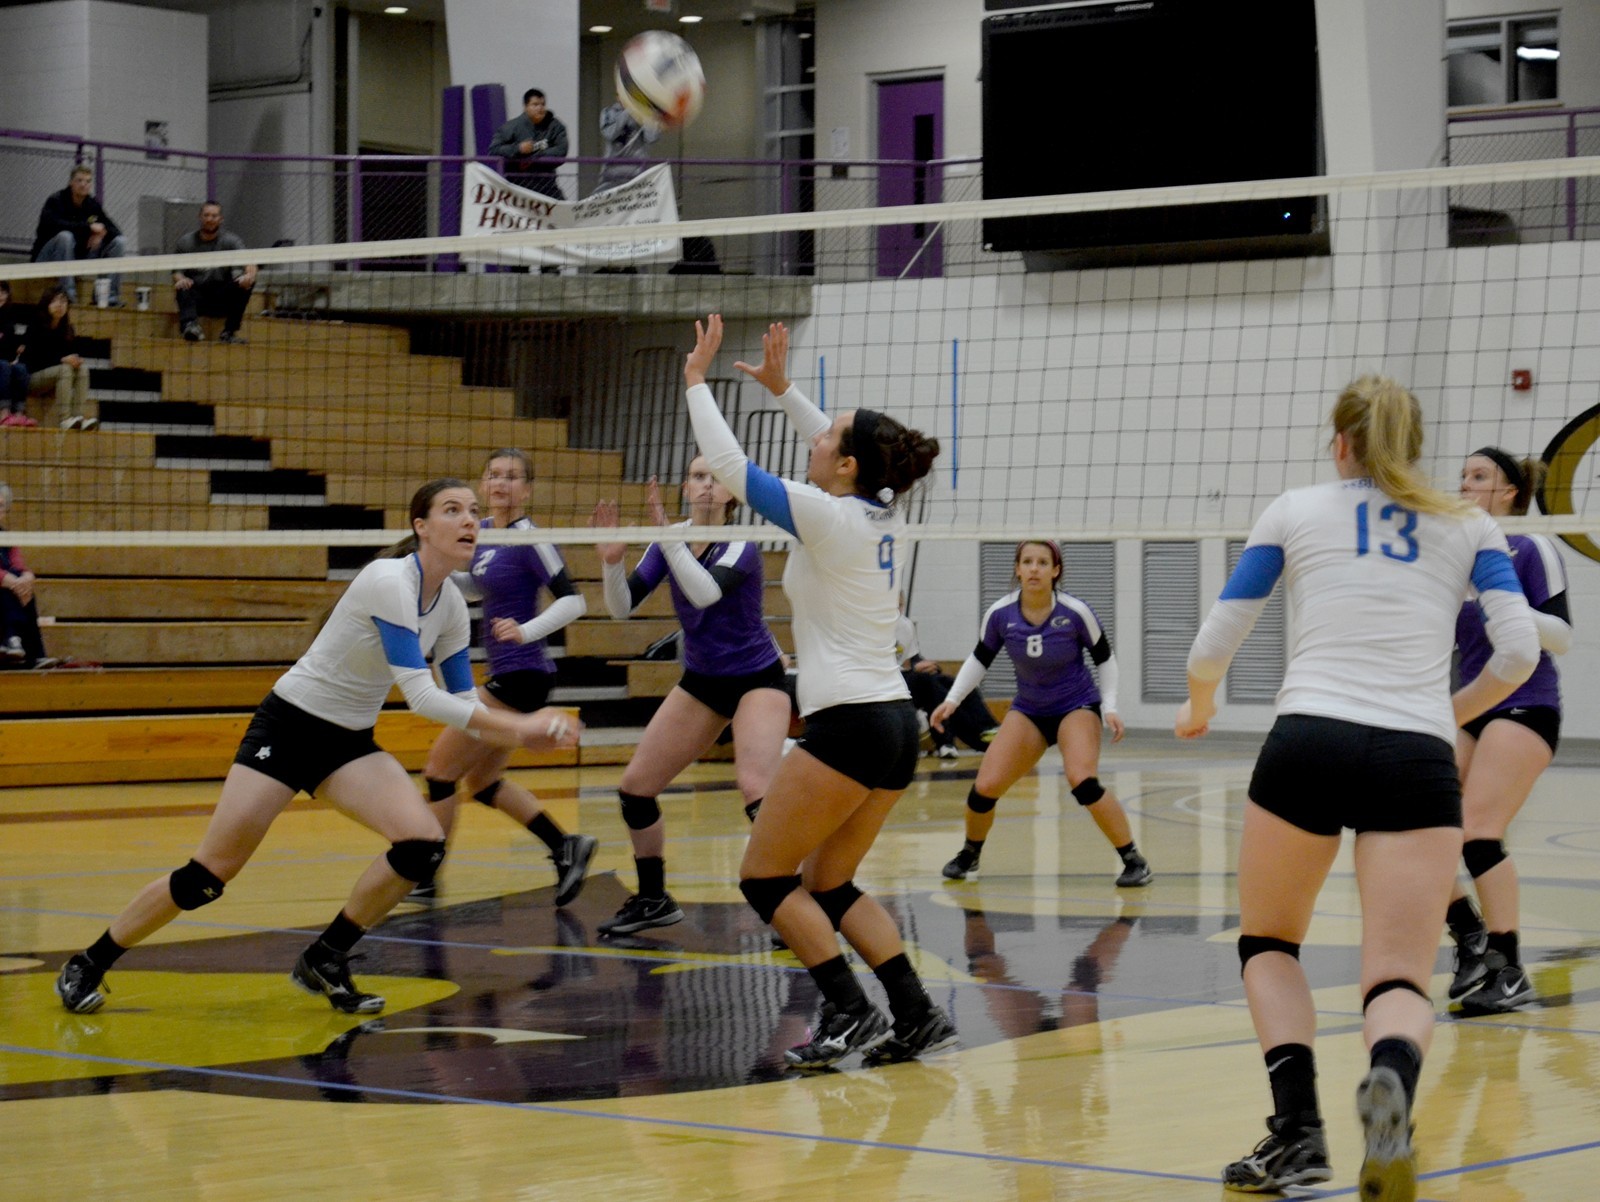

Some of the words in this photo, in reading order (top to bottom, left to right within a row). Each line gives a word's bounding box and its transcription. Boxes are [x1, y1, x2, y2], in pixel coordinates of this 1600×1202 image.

[471, 183, 556, 216] DRURY
[1356, 501, 1419, 563] 13
[472, 549, 497, 576] 2
[878, 534, 895, 590] 9
[1026, 634, 1043, 658] 8
